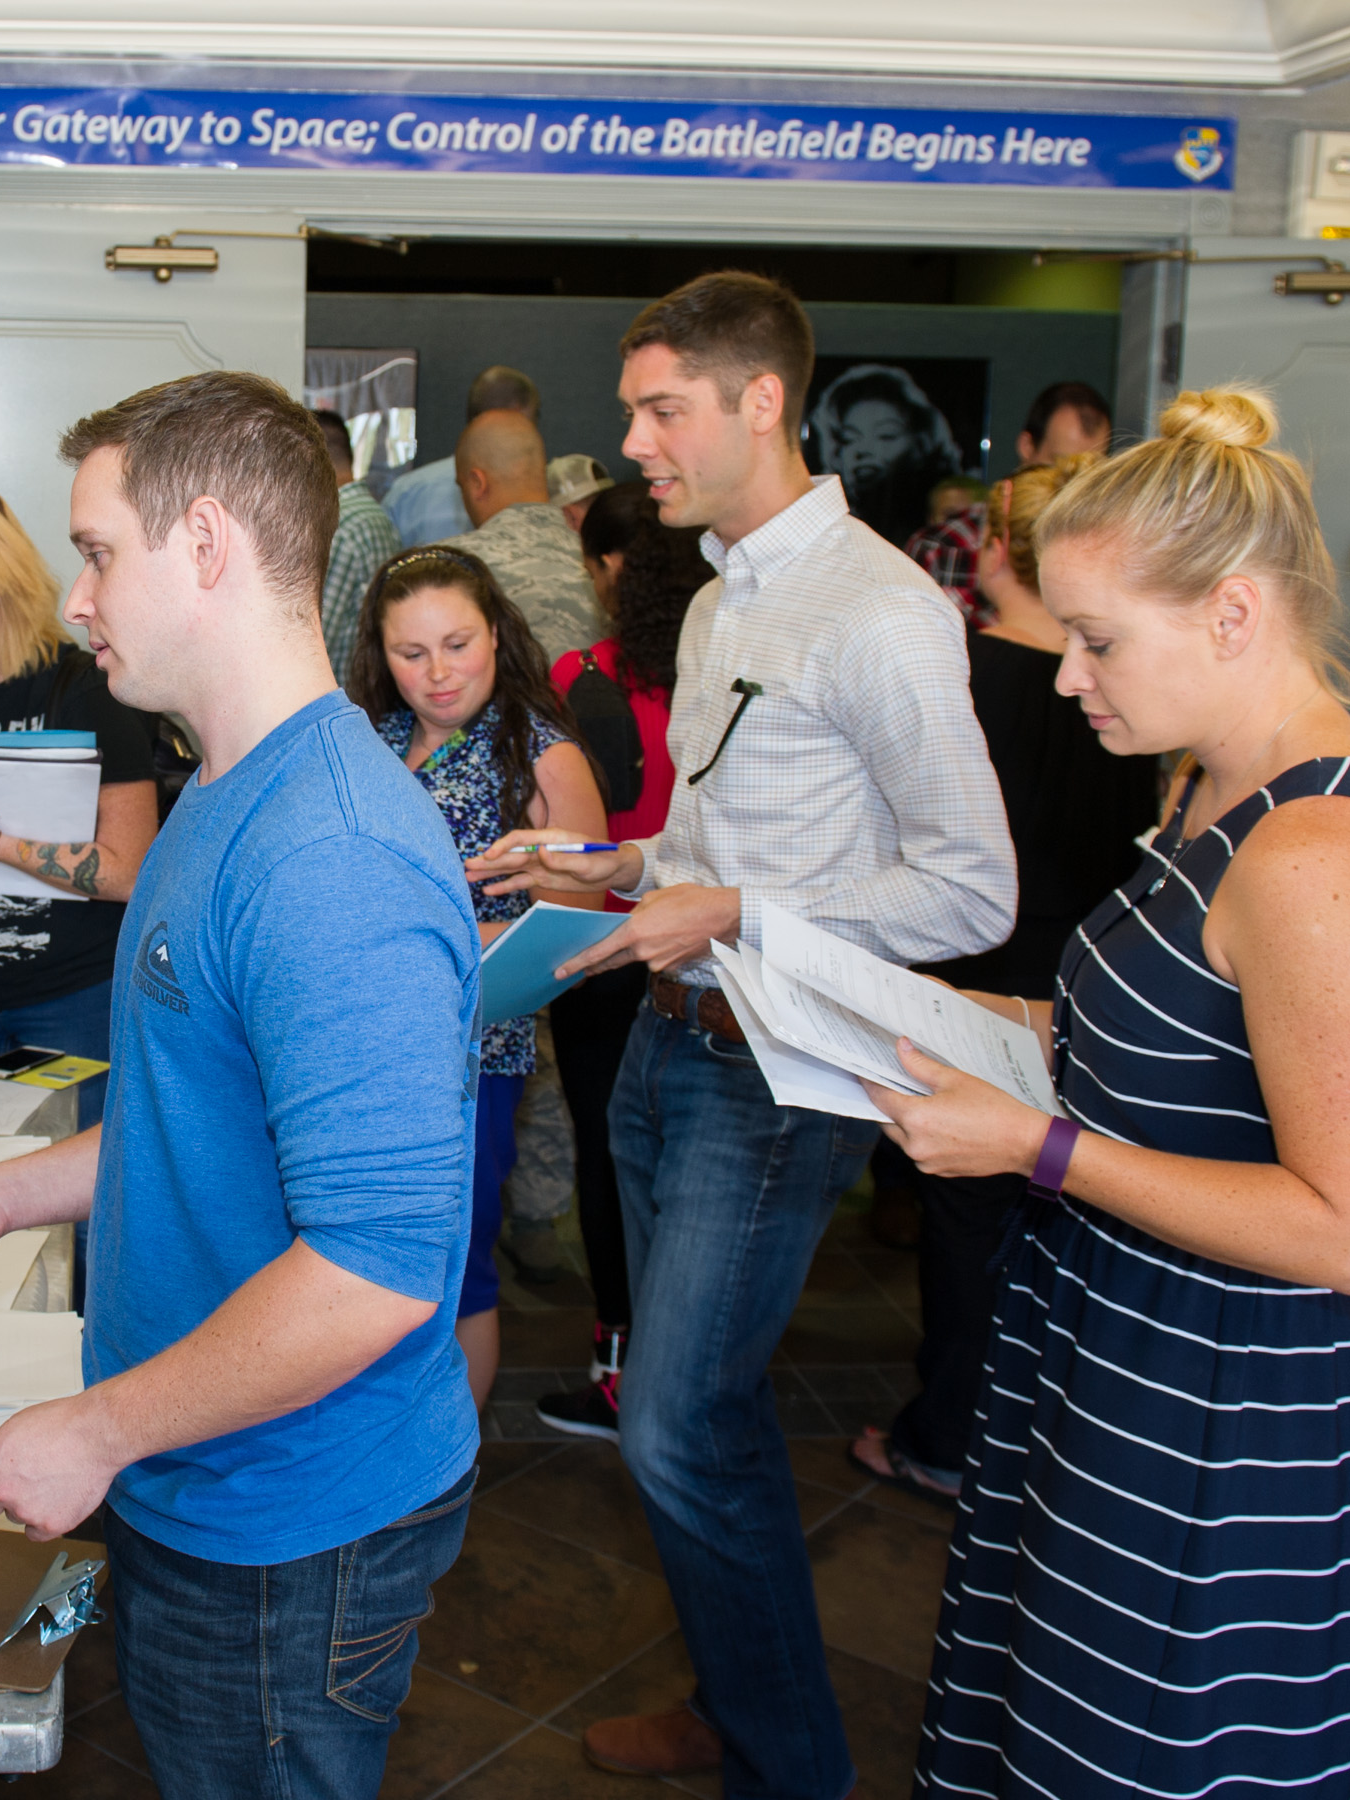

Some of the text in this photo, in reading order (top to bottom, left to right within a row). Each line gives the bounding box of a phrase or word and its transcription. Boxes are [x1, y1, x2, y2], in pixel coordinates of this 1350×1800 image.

[13, 104, 193, 155] Gateway
[200, 110, 241, 145] to
[249, 108, 380, 155] Space;
[386, 112, 537, 153] Control
[541, 113, 589, 153] of
[590, 115, 655, 156] the
[661, 118, 864, 160] Battlefield
[866, 123, 996, 172] Begins
[1001, 127, 1091, 167] Here
